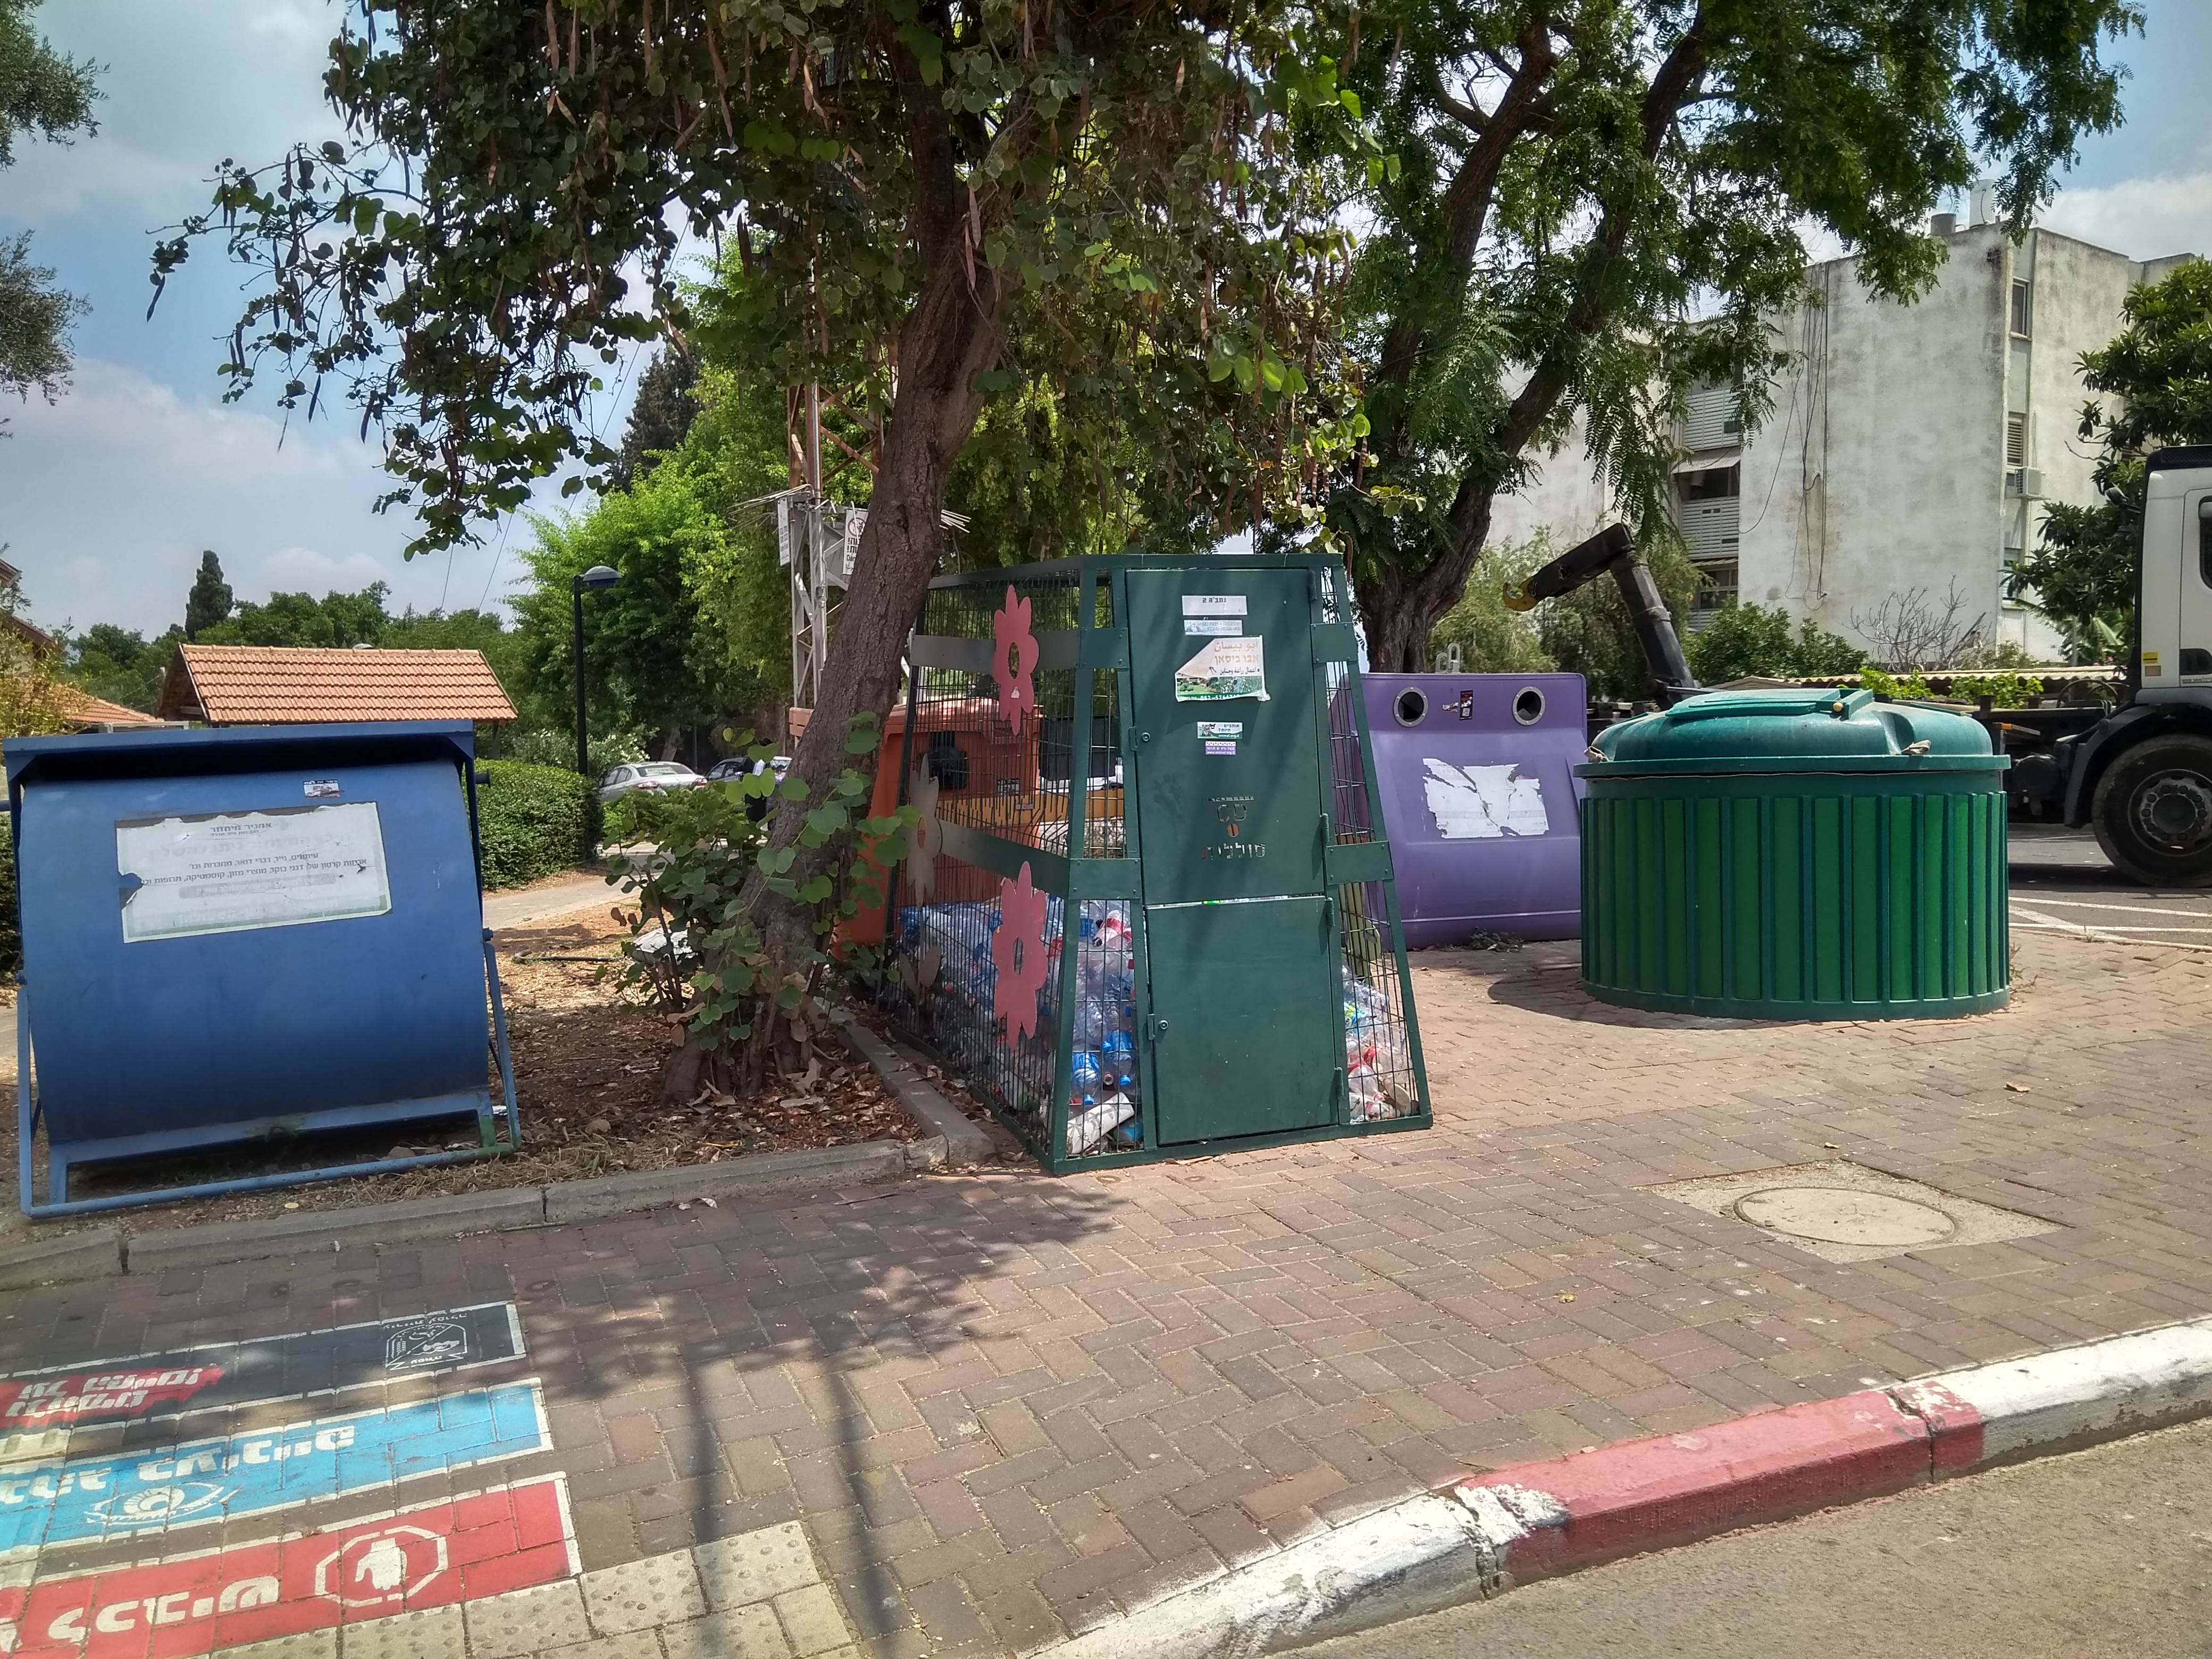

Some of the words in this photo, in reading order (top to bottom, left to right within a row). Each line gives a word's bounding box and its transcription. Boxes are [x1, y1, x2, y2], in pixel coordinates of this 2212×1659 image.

[1214, 655, 1241, 665] ביסאן
[1243, 655, 1259, 663] אבו
[1217, 803, 1247, 822] CD
[322, 861, 341, 870] קרטון
[183, 872, 225, 882] קוסמטיקה,
[227, 870, 244, 878] מזון,
[154, 876, 182, 884] תרופות
[429, 1313, 467, 1324] עפולה
[18, 1380, 68, 1400] על
[138, 1426, 355, 1482] בעיניים
[48, 1575, 280, 1646] לכביש
